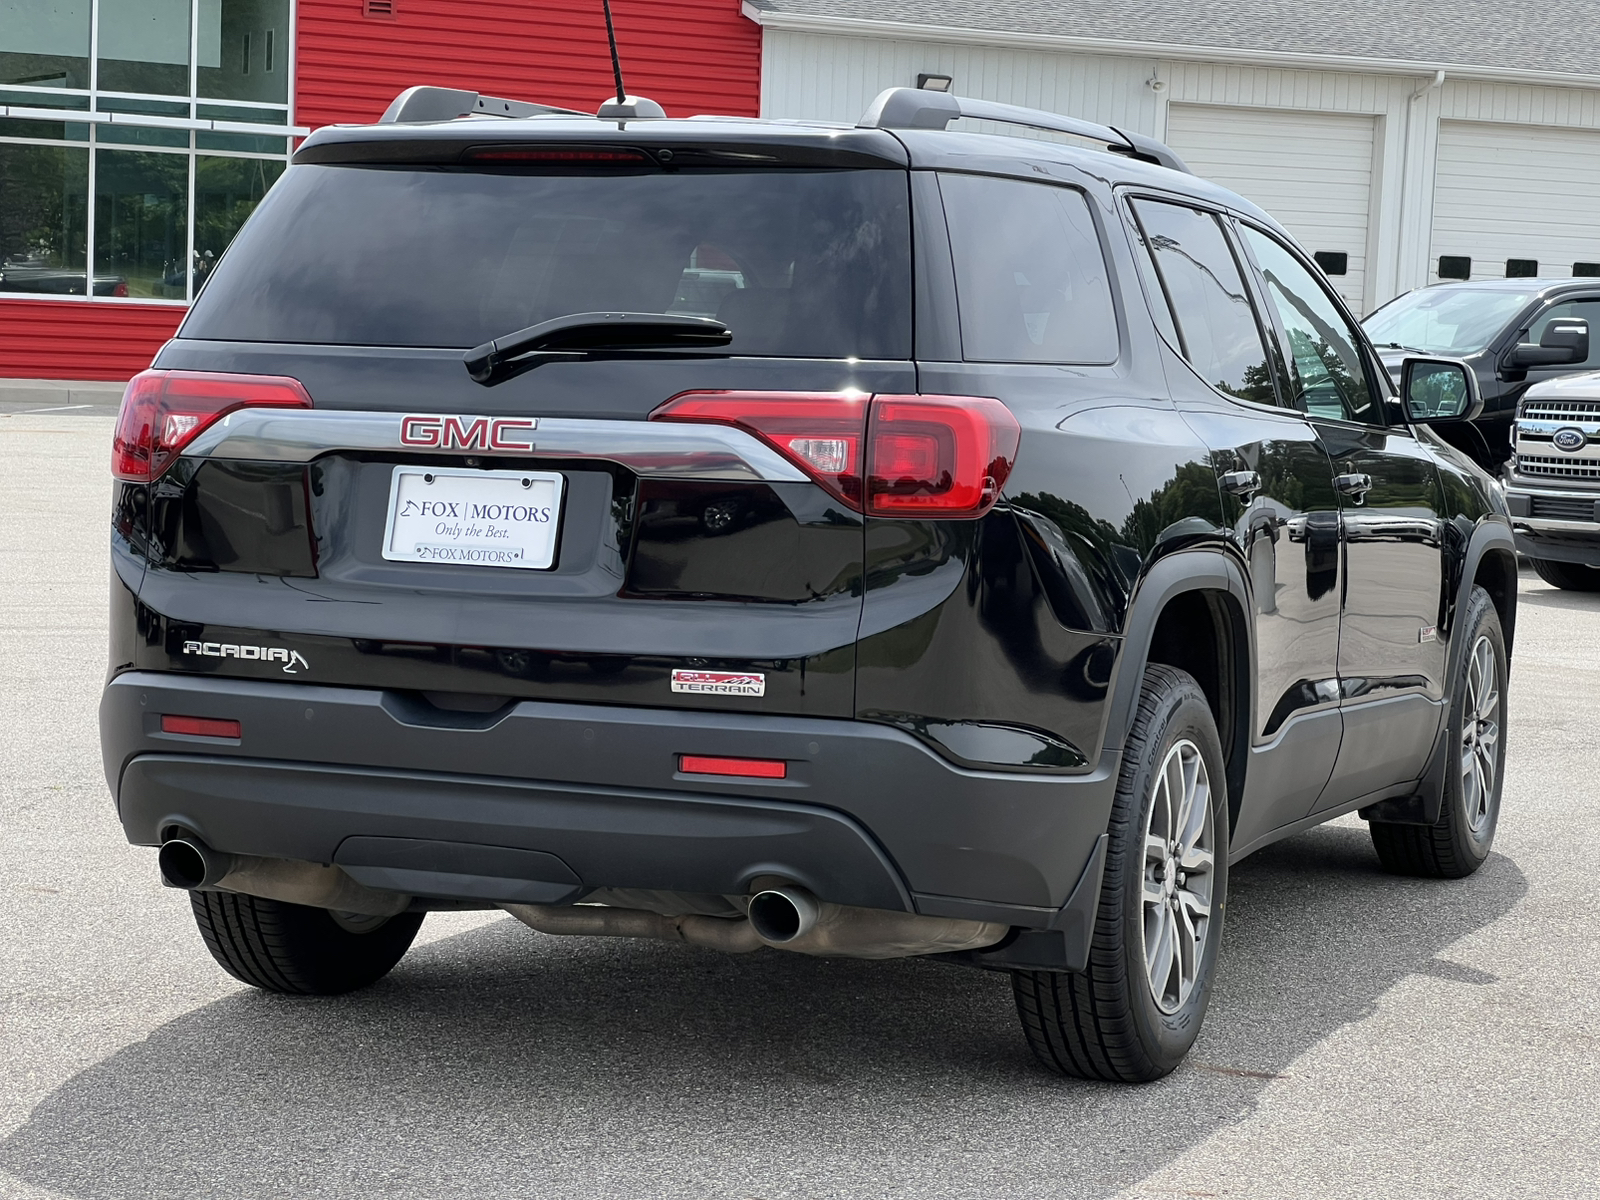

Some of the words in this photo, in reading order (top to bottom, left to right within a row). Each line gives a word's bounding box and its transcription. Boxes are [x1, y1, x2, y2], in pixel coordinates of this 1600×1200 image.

[400, 414, 538, 452] GMC
[1559, 433, 1576, 445] Ford
[420, 501, 460, 518] FOX
[470, 504, 551, 523] MOTORS
[435, 522, 462, 540] Only
[464, 523, 483, 538] the
[485, 525, 510, 539] Best.
[431, 547, 457, 560] FOX
[458, 549, 513, 563] MOTORS
[183, 640, 288, 662] ACADIA
[680, 673, 716, 683] ALL
[676, 683, 760, 694] TERRAIN
